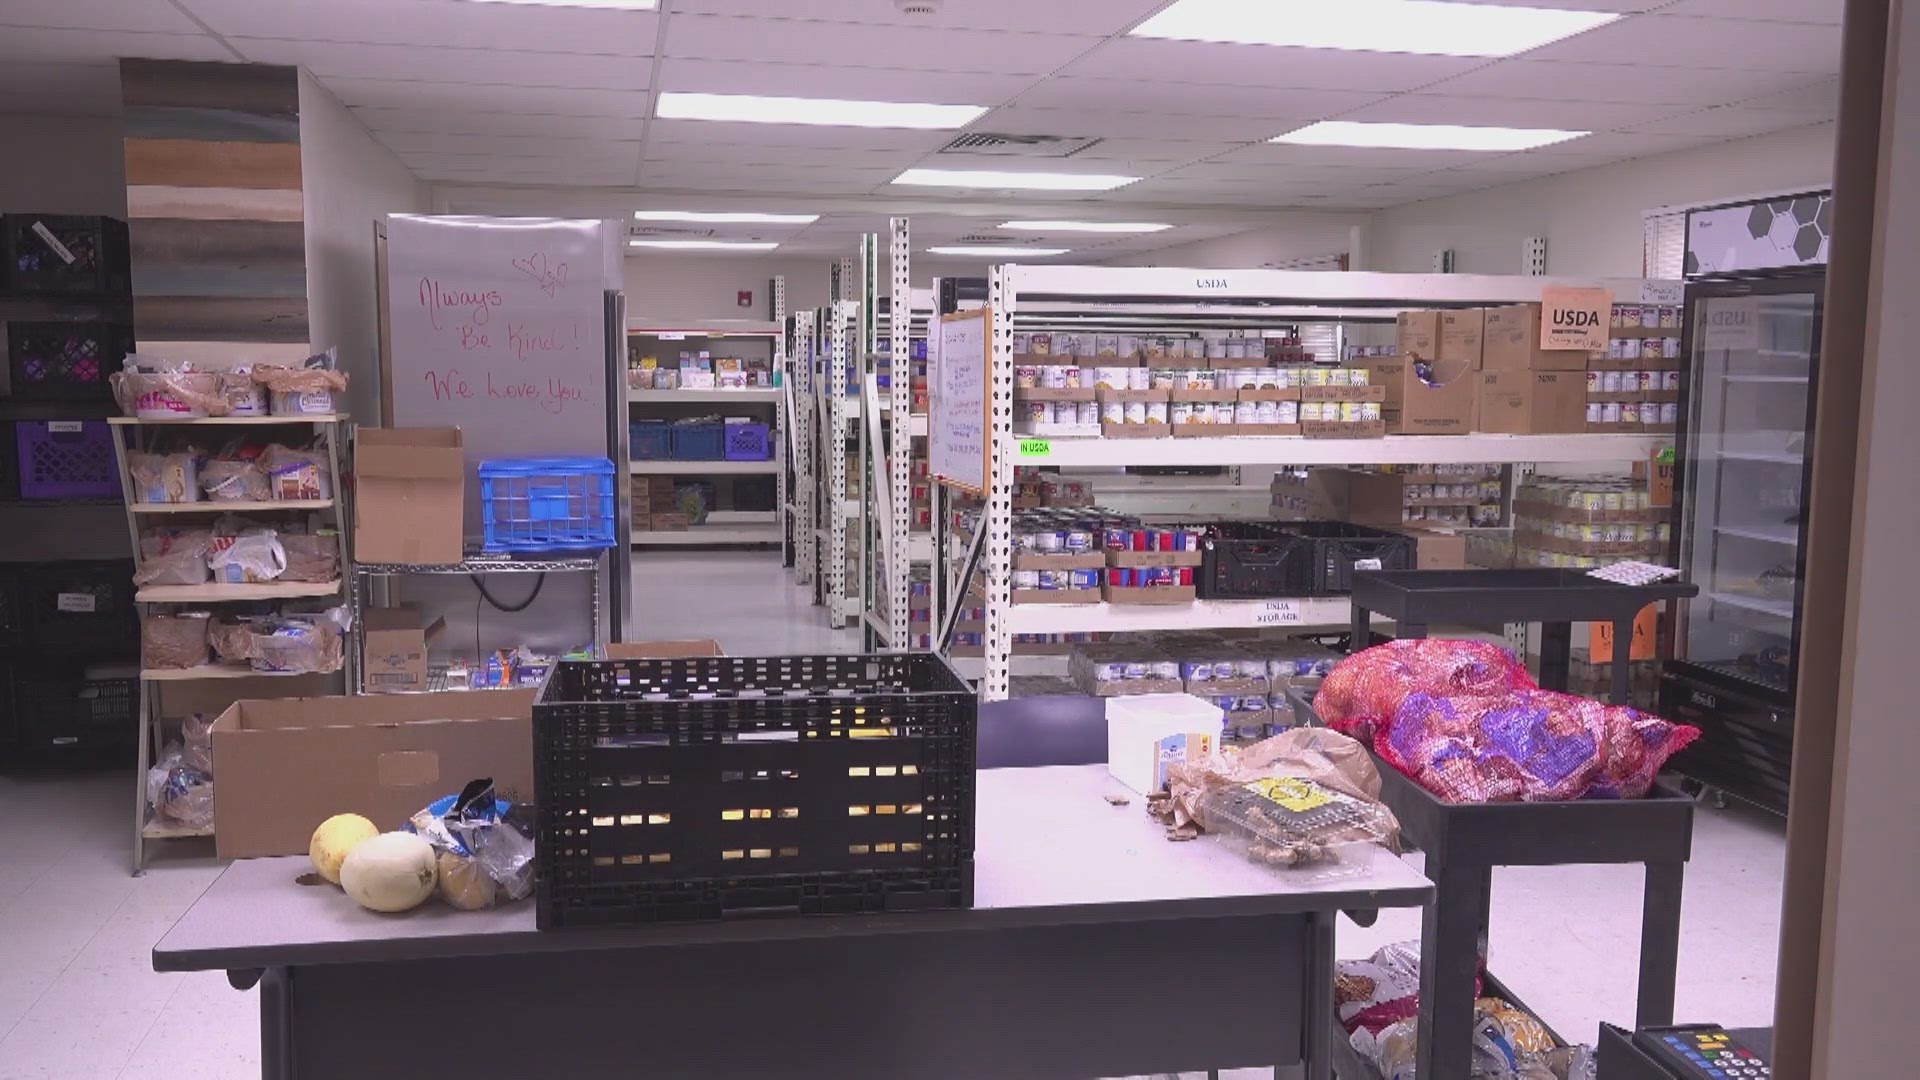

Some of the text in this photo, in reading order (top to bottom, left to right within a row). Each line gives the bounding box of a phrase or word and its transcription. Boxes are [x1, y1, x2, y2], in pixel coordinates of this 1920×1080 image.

[1196, 279, 1227, 289] USDA
[419, 276, 503, 332] Always
[1552, 308, 1600, 327] USDA
[457, 325, 491, 350] Be
[424, 368, 475, 401] We
[1020, 442, 1049, 453] IN USDA
[1266, 602, 1290, 611] USDA
[1257, 612, 1298, 623] STORAGE
